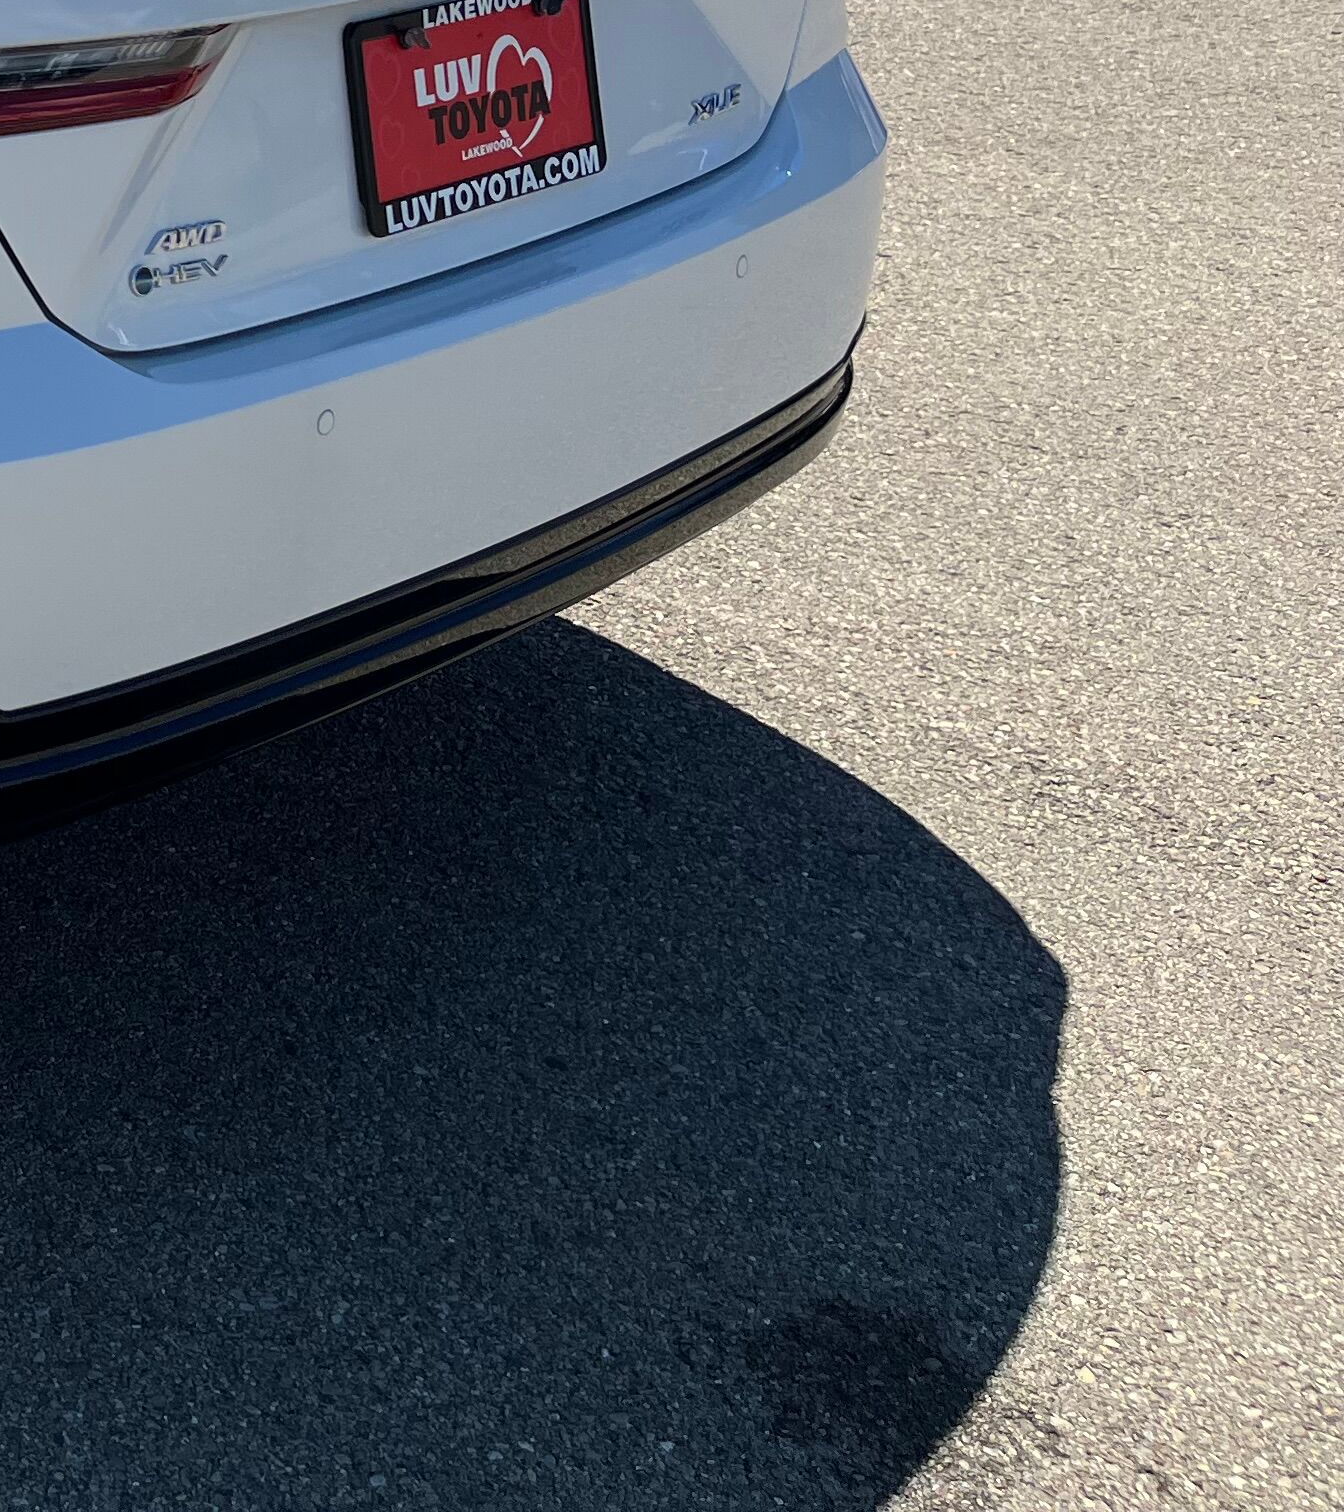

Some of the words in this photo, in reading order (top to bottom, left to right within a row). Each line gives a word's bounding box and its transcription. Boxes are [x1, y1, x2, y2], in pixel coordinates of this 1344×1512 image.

[413, 54, 482, 107] LUV
[688, 83, 742, 126] XLE
[428, 79, 551, 146] TOYOTA
[461, 137, 513, 161] LAKEWOOD
[385, 145, 600, 234] LUVTOYOTA.COM
[144, 219, 227, 256] AWD
